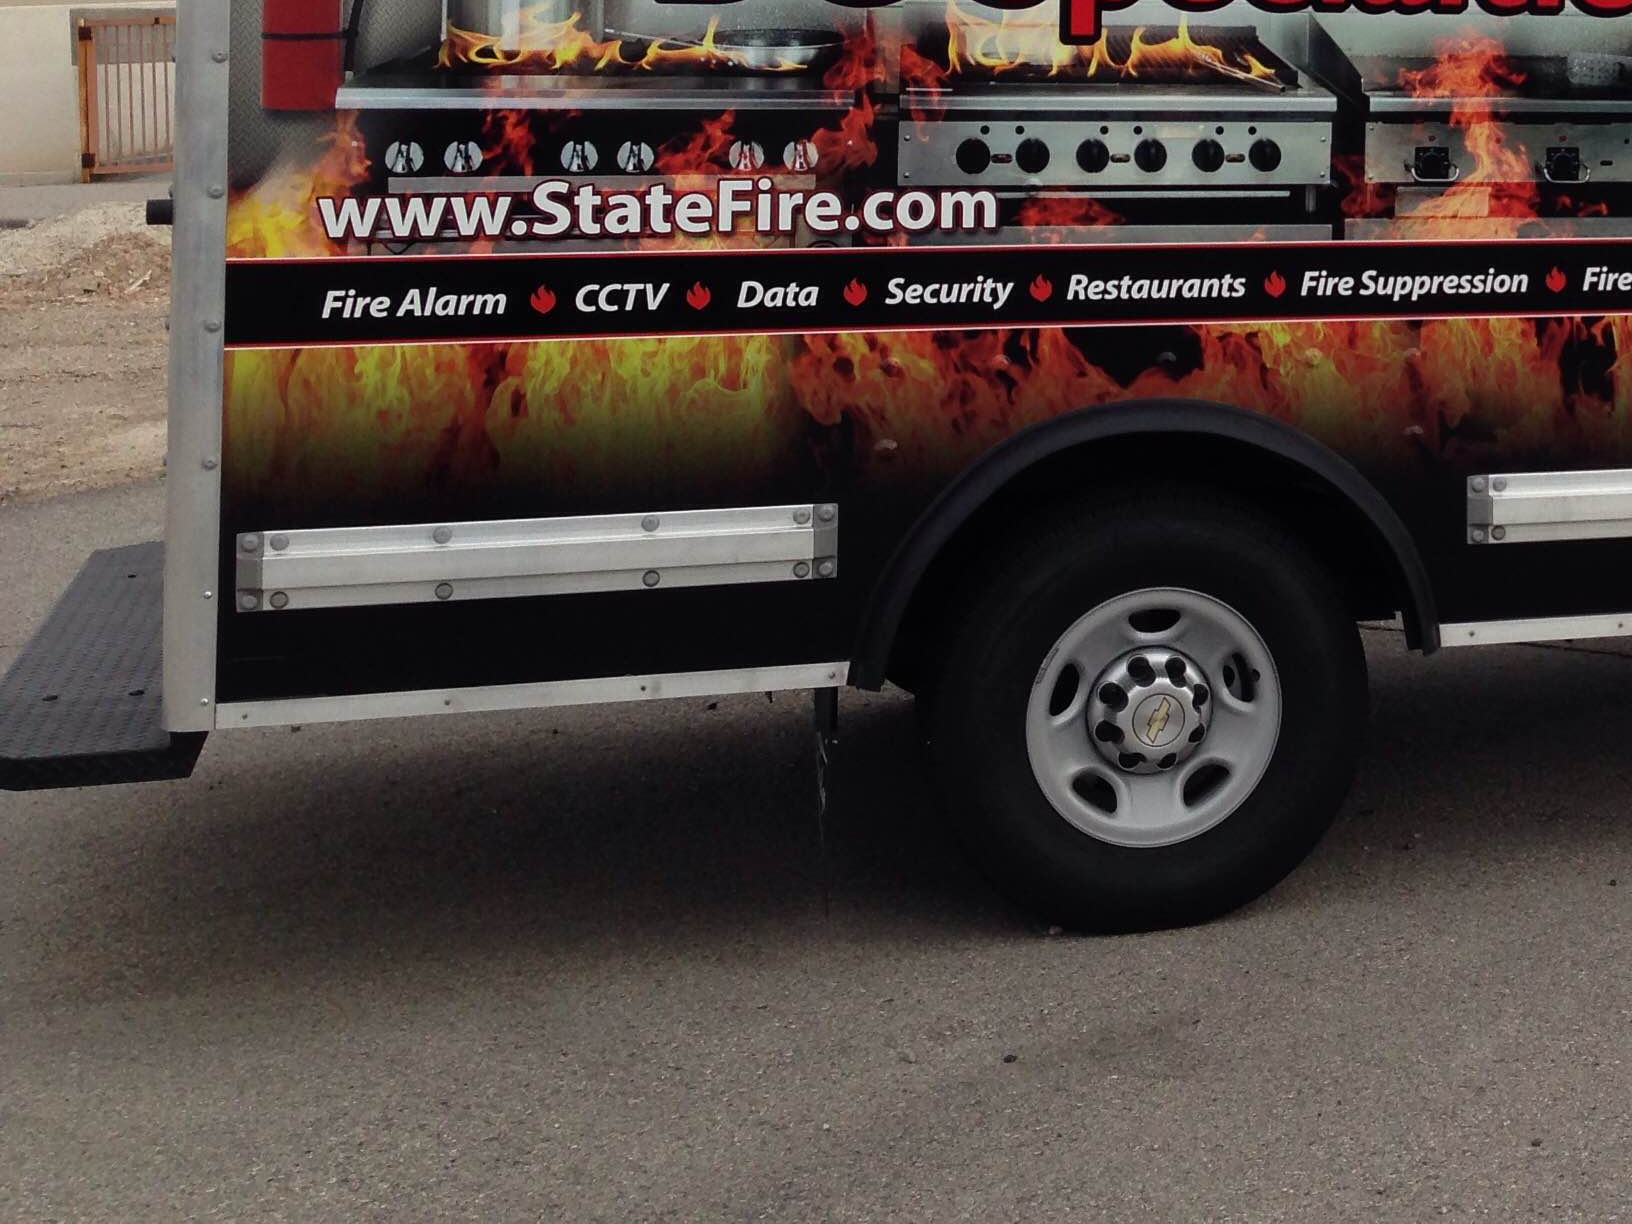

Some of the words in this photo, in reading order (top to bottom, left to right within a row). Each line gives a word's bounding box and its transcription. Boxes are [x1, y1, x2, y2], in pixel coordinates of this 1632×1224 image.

[319, 179, 995, 237] www.StateFire.com
[322, 289, 390, 318] Fire
[396, 287, 506, 316] Alarm
[576, 283, 670, 312] CCTV
[737, 281, 819, 307] Data
[885, 276, 1014, 309] Security
[1067, 274, 1246, 300] Restaurants
[1301, 270, 1354, 296] Fire
[1359, 268, 1528, 301] Suppression
[1583, 266, 1632, 291] Fire
